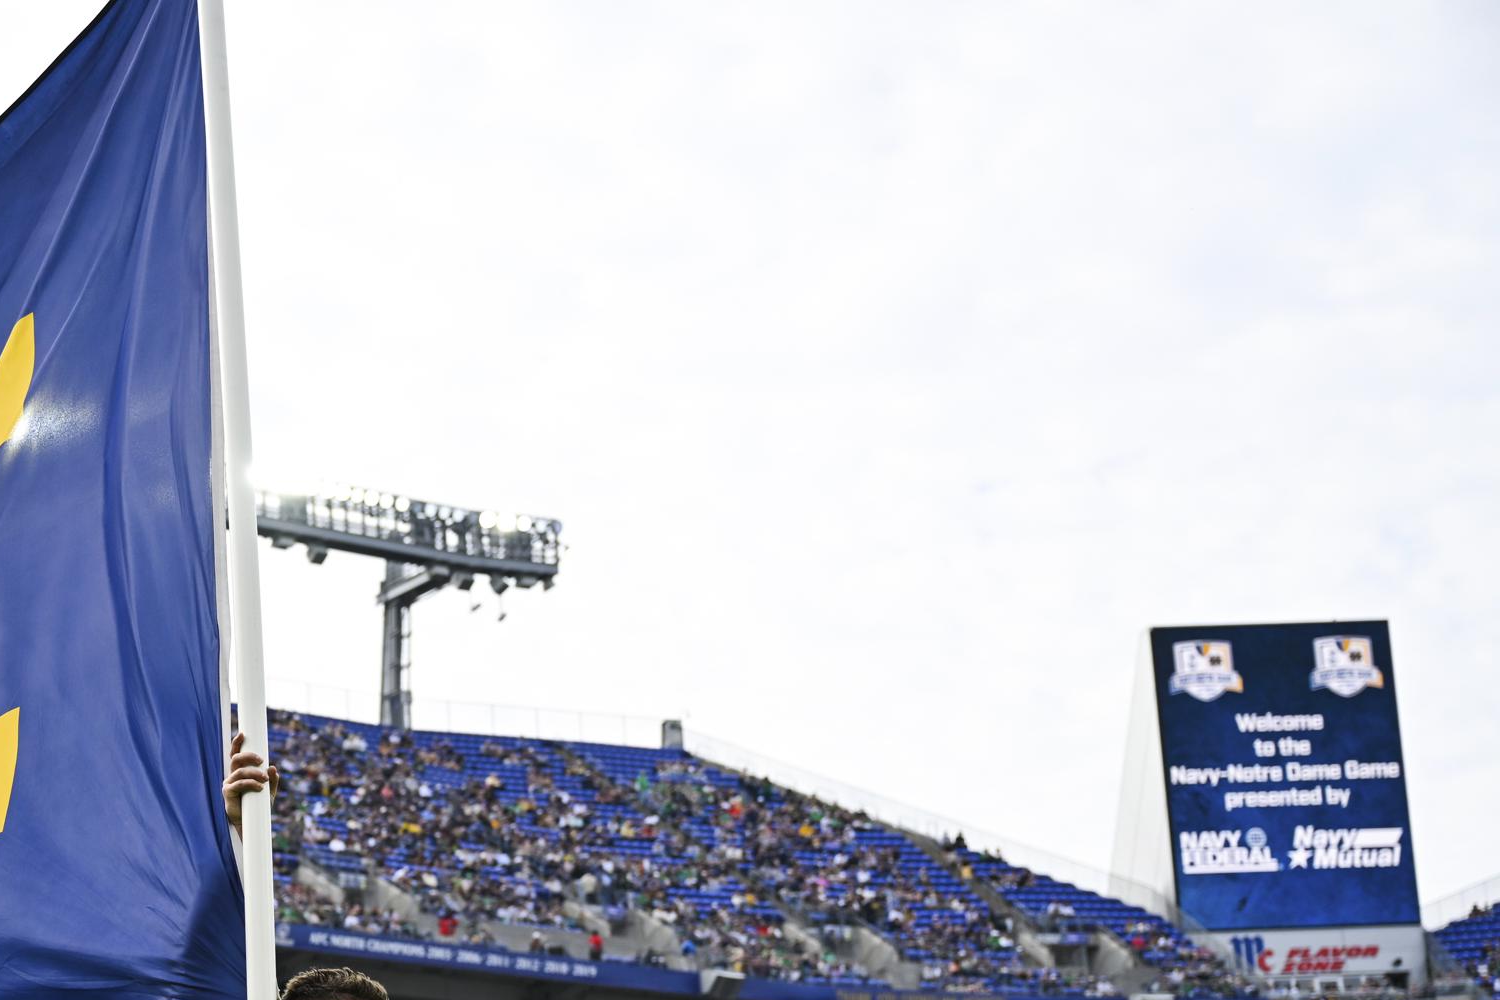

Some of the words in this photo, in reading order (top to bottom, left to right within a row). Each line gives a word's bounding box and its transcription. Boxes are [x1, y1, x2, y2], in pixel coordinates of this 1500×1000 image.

[1235, 712, 1324, 733] Welcome
[1253, 738, 1275, 757] to
[1278, 736, 1311, 757] the
[1170, 763, 1283, 787] Navy-Notre
[1285, 761, 1341, 782] Dame
[1344, 759, 1400, 779] Game
[1224, 786, 1322, 812] presented
[1325, 785, 1350, 808] by
[1180, 829, 1241, 850] NAVY
[1294, 825, 1357, 849] Navy
[1313, 846, 1401, 869] Mutual
[1286, 945, 1380, 960] FLAVOR
